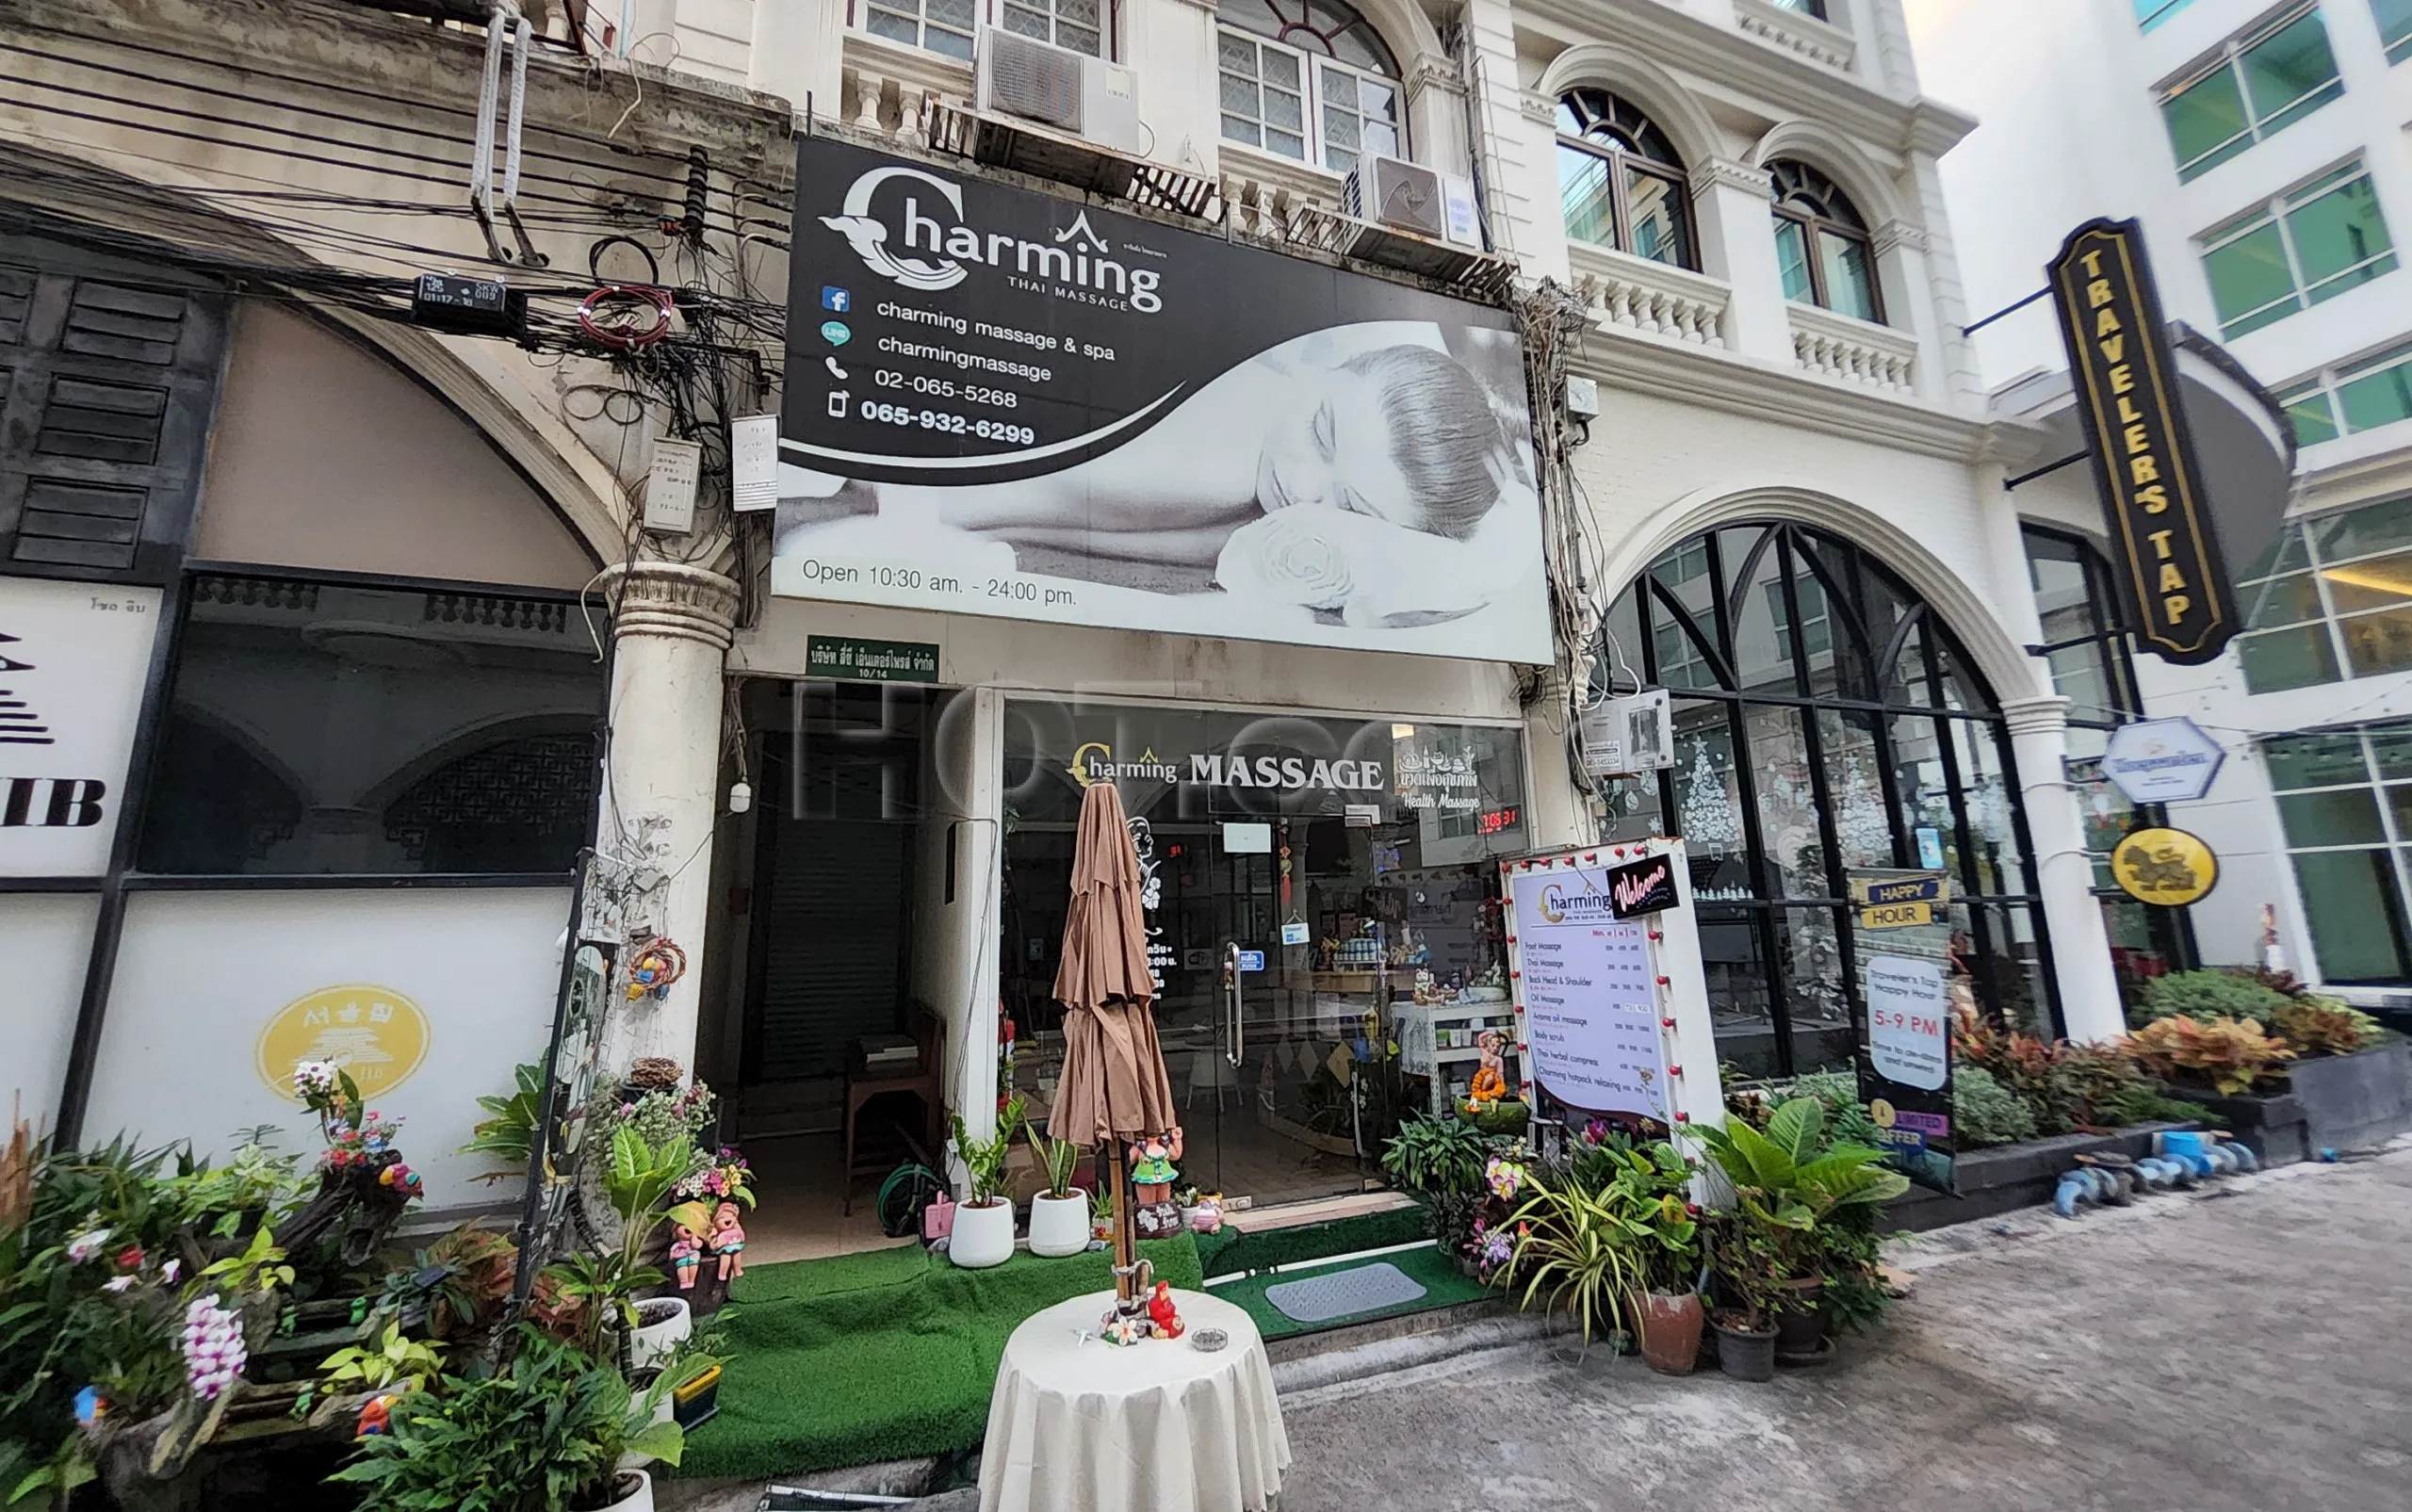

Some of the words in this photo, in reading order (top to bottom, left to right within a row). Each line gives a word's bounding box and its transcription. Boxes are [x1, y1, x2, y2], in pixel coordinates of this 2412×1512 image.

[817, 167, 1163, 314] Charming
[1007, 276, 1046, 294] THAI
[1055, 285, 1129, 312] MASSAGE
[877, 300, 967, 334] charming
[974, 320, 1057, 351] massage
[1064, 336, 1077, 353] &
[1083, 341, 1116, 362] spa
[877, 335, 1052, 382] charmingmassage
[874, 369, 1018, 409] 02-065-5268
[860, 399, 1035, 446] 065-932-6299
[803, 559, 858, 585] Open
[870, 566, 921, 590] 10:30
[929, 576, 964, 594] am.
[987, 577, 1037, 602] 24:00
[1044, 588, 1077, 607] pm.
[2147, 528, 2192, 626] TAP
[858, 668, 888, 678] 10/14
[1065, 742, 1178, 789] Charming
[1189, 754, 1385, 790] MASSAGE
[0, 776, 106, 828] IB
[1401, 791, 1436, 810] Health
[1437, 792, 1481, 814] Massage
[1538, 883, 1613, 924] Charming
[1614, 864, 1667, 913] Welcome
[1879, 884, 1925, 902] HAPPY
[1872, 907, 1917, 925] HOUR
[1538, 943, 1562, 953] Massage
[1540, 958, 1564, 969] Massage
[1542, 975, 1556, 985] Head
[1565, 977, 1592, 987] Shoulder
[1530, 993, 1540, 1002] Oil
[1562, 1016, 1588, 1028] massage
[1874, 1009, 1904, 1030] 5-9
[1911, 1016, 1939, 1037] PM
[1538, 1066, 1567, 1081] Charming
[1550, 1051, 1569, 1062] herbal
[1570, 1055, 1600, 1066] compress
